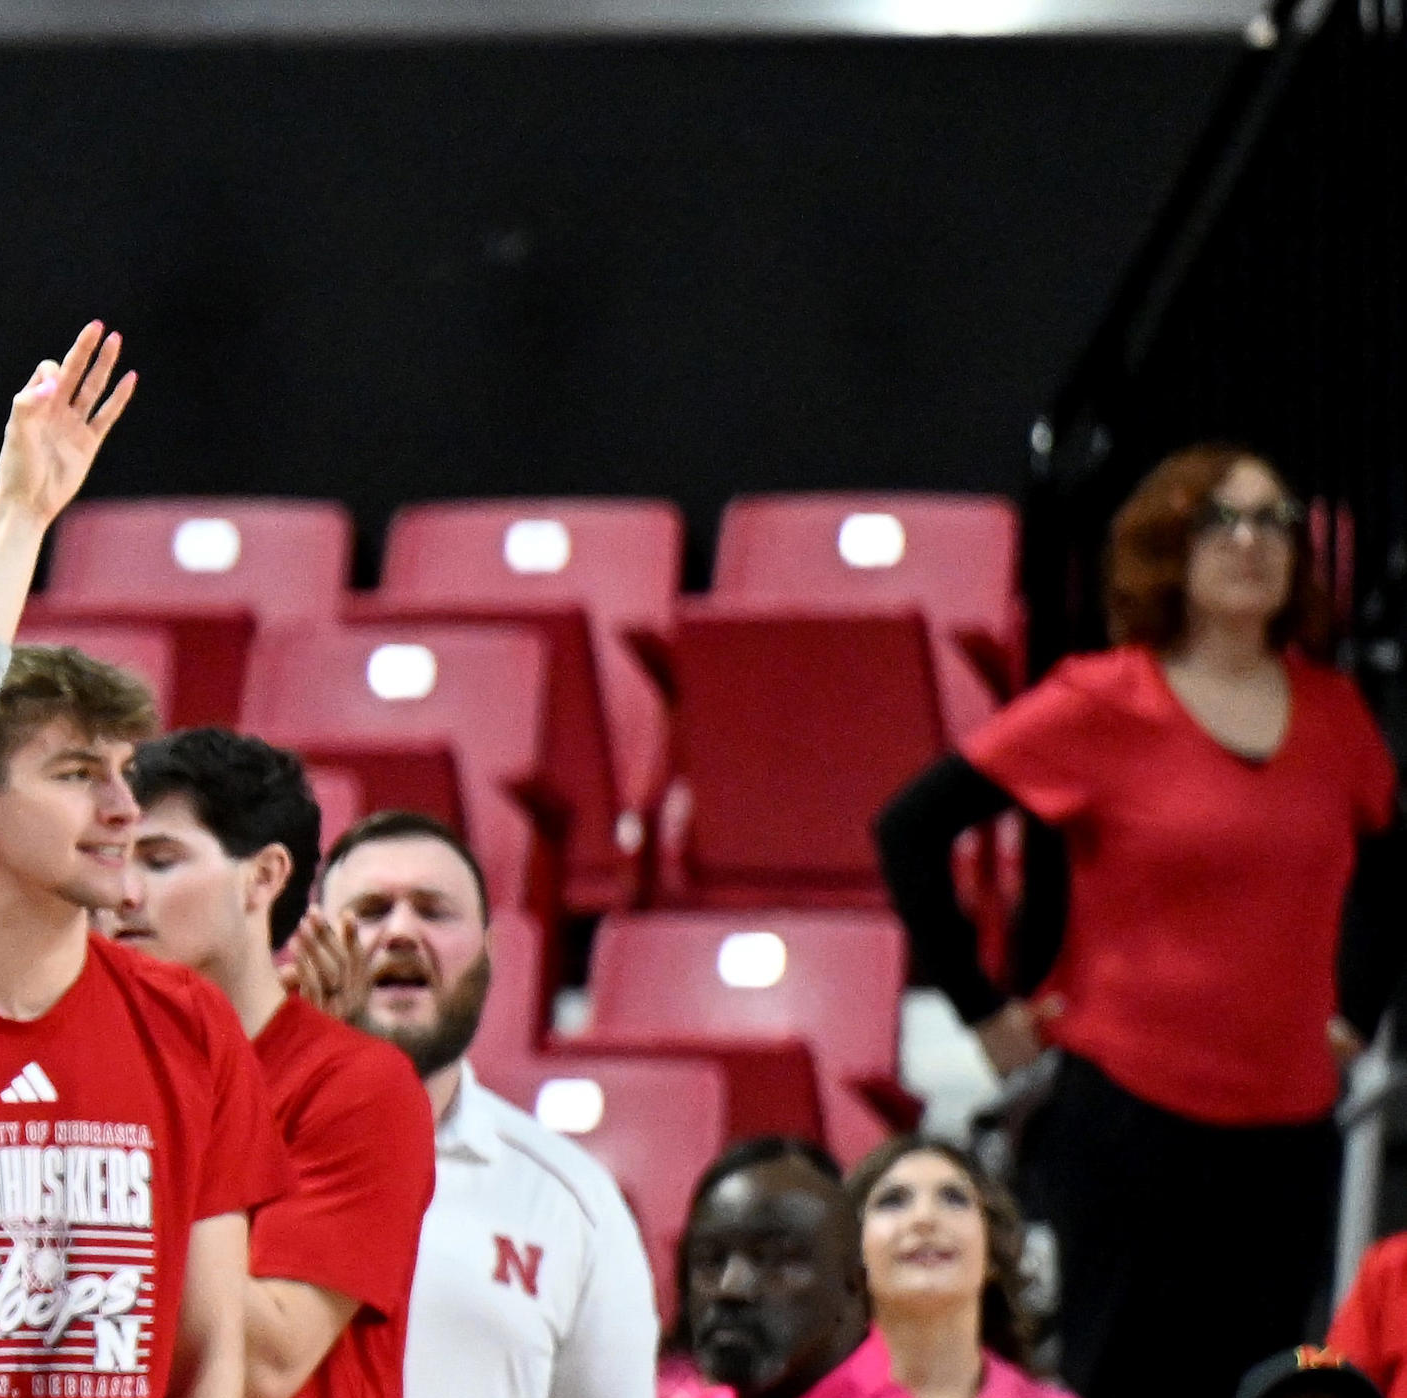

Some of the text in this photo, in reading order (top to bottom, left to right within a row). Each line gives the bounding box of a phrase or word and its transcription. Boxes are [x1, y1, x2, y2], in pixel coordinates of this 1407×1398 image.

[25, 1121, 50, 1146] OF
[54, 1120, 150, 1147] NEBRASKA
[492, 1234, 544, 1298] N
[93, 1314, 141, 1372] N
